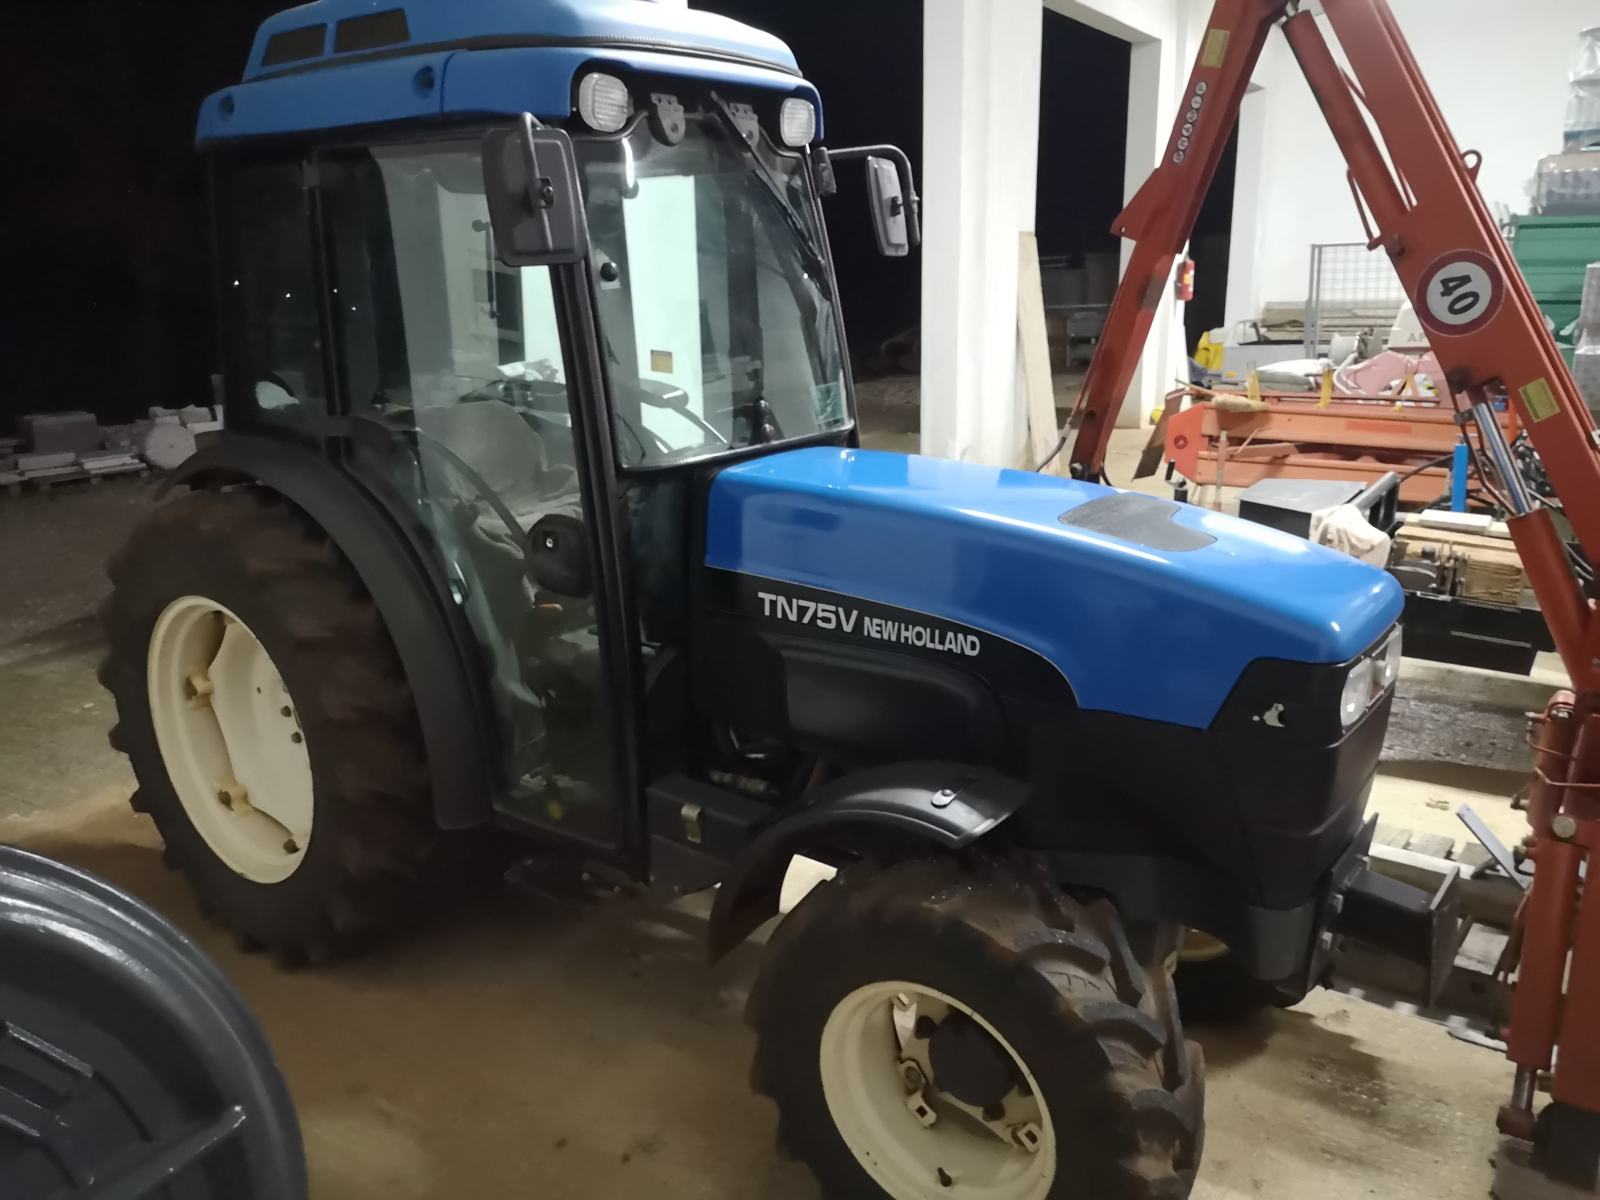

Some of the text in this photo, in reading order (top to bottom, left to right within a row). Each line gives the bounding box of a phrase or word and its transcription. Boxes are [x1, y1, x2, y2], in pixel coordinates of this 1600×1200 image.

[1440, 275, 1480, 315] 40
[757, 591, 981, 657] TN75V NEW HOLLAND
